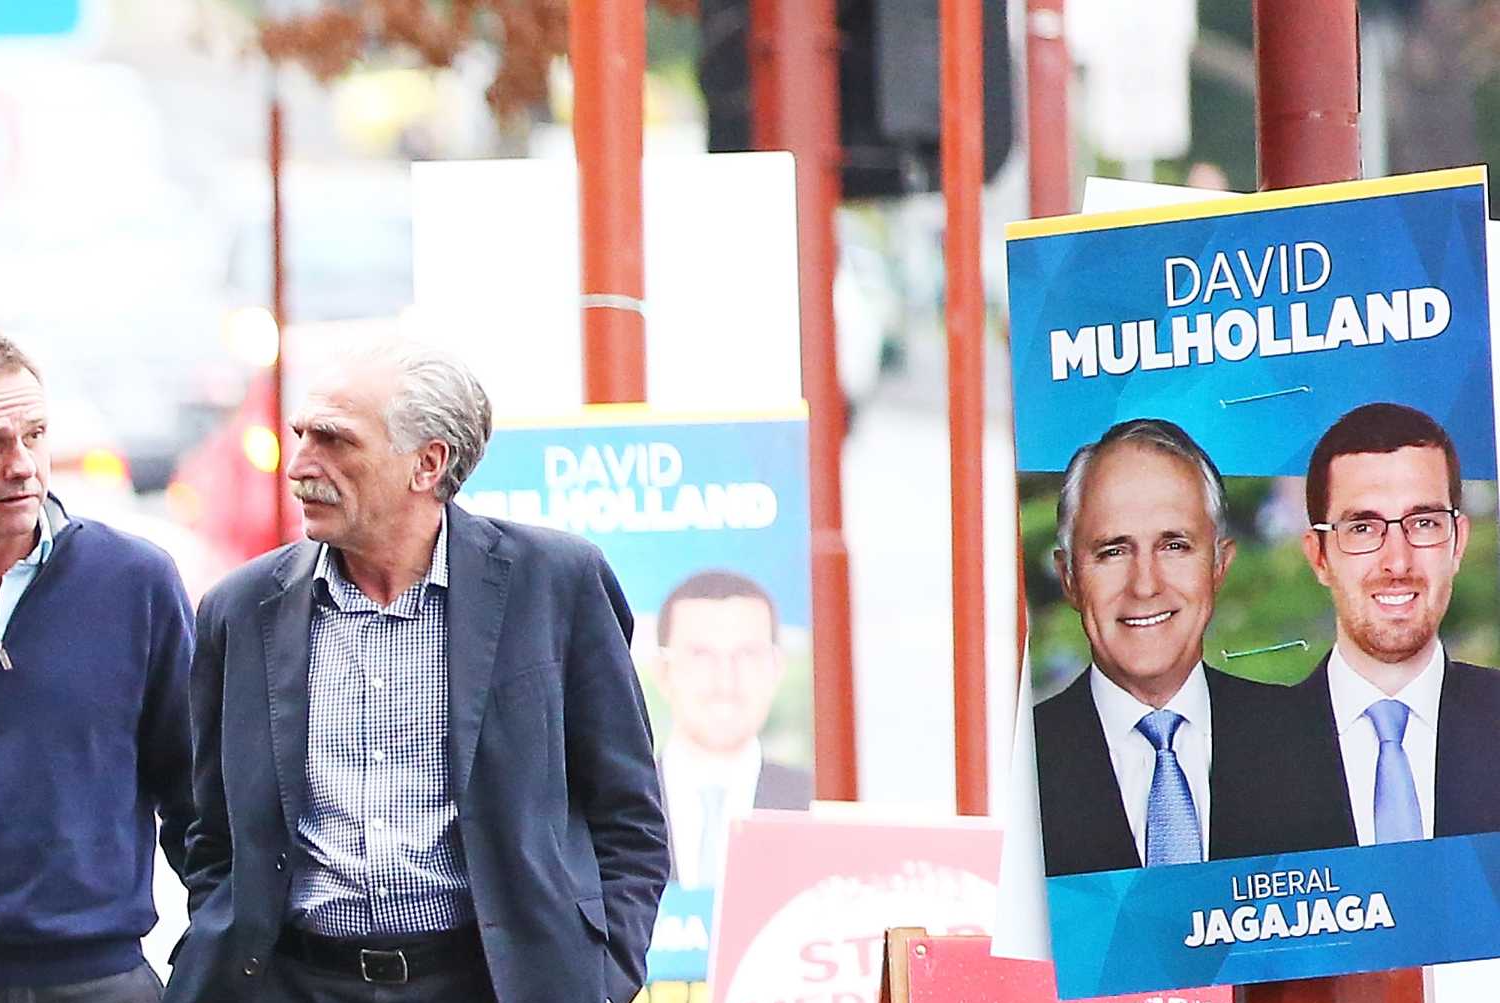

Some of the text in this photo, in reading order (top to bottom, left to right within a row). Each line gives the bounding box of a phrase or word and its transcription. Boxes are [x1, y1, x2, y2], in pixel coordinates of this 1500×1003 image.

[1164, 241, 1331, 307] DAVID
[1050, 287, 1451, 380] MULHOLLAND
[543, 442, 683, 488] DAVID
[1232, 867, 1340, 900] LIBERAL
[1185, 893, 1395, 947] JAGAJAGA
